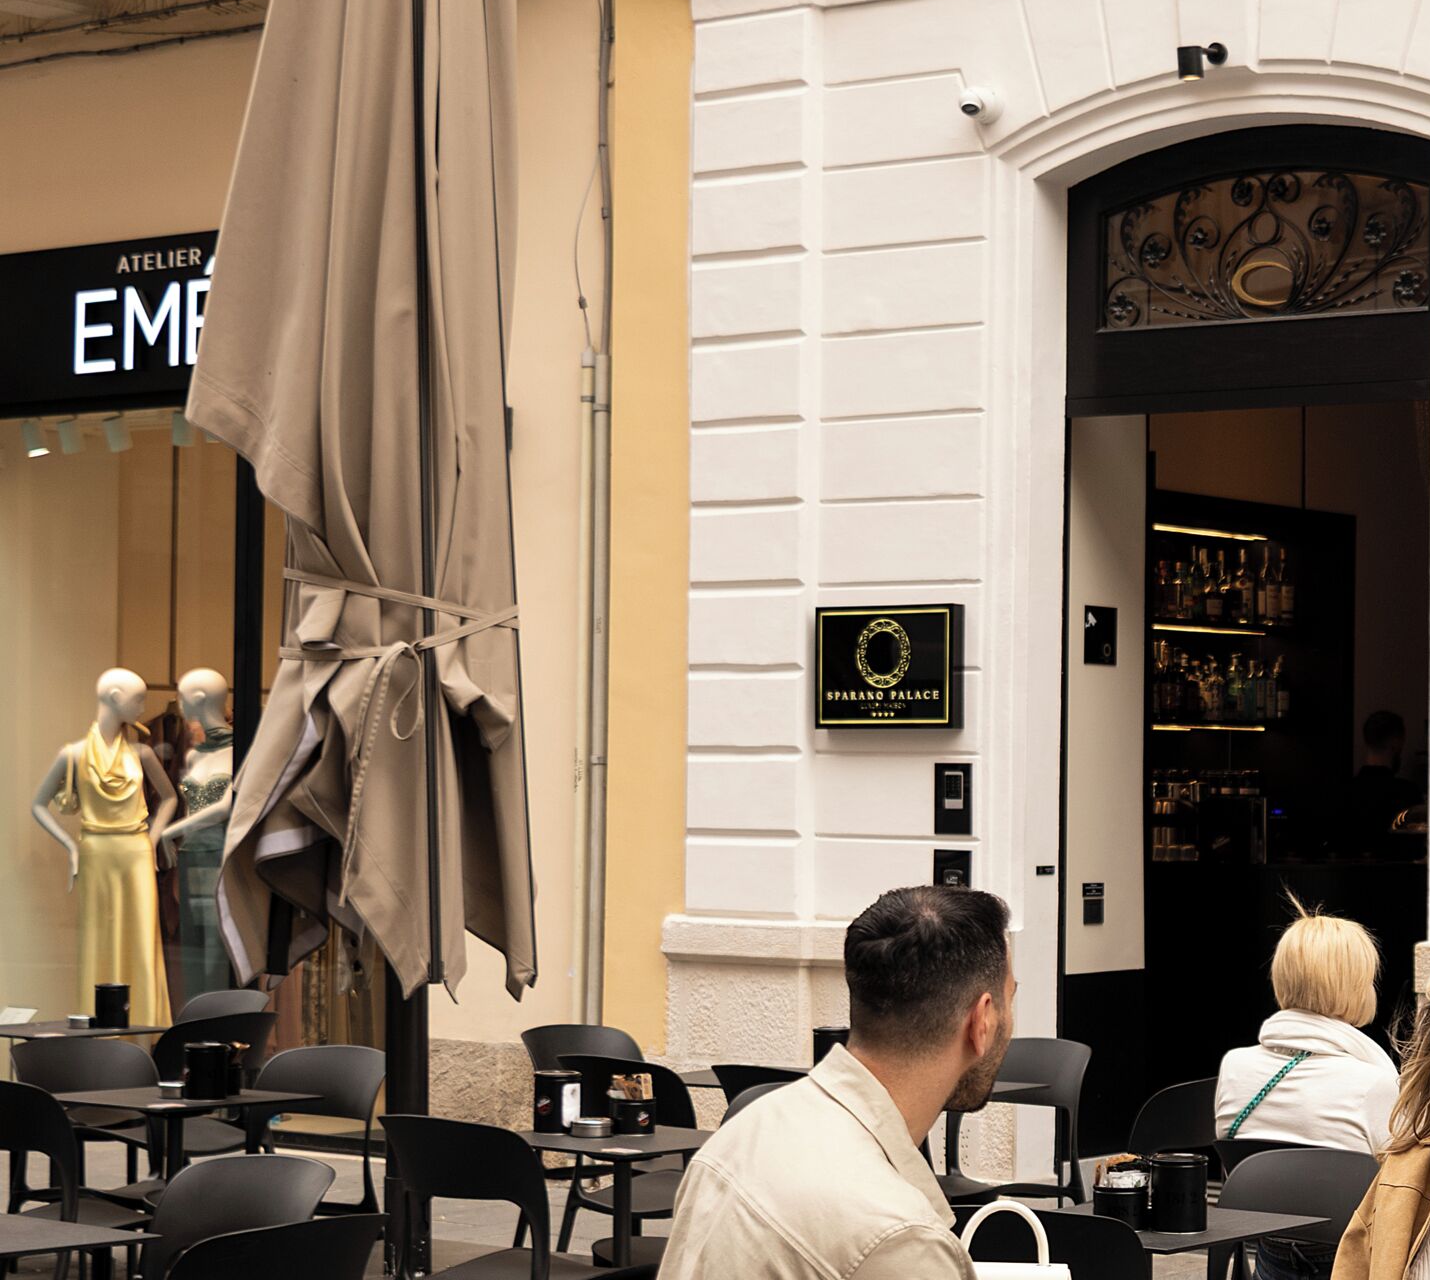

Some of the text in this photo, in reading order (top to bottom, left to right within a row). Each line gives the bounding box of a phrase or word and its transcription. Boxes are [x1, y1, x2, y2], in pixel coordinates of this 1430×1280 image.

[116, 248, 202, 274] ATELIER
[826, 690, 940, 700] SPARANO PALACE
